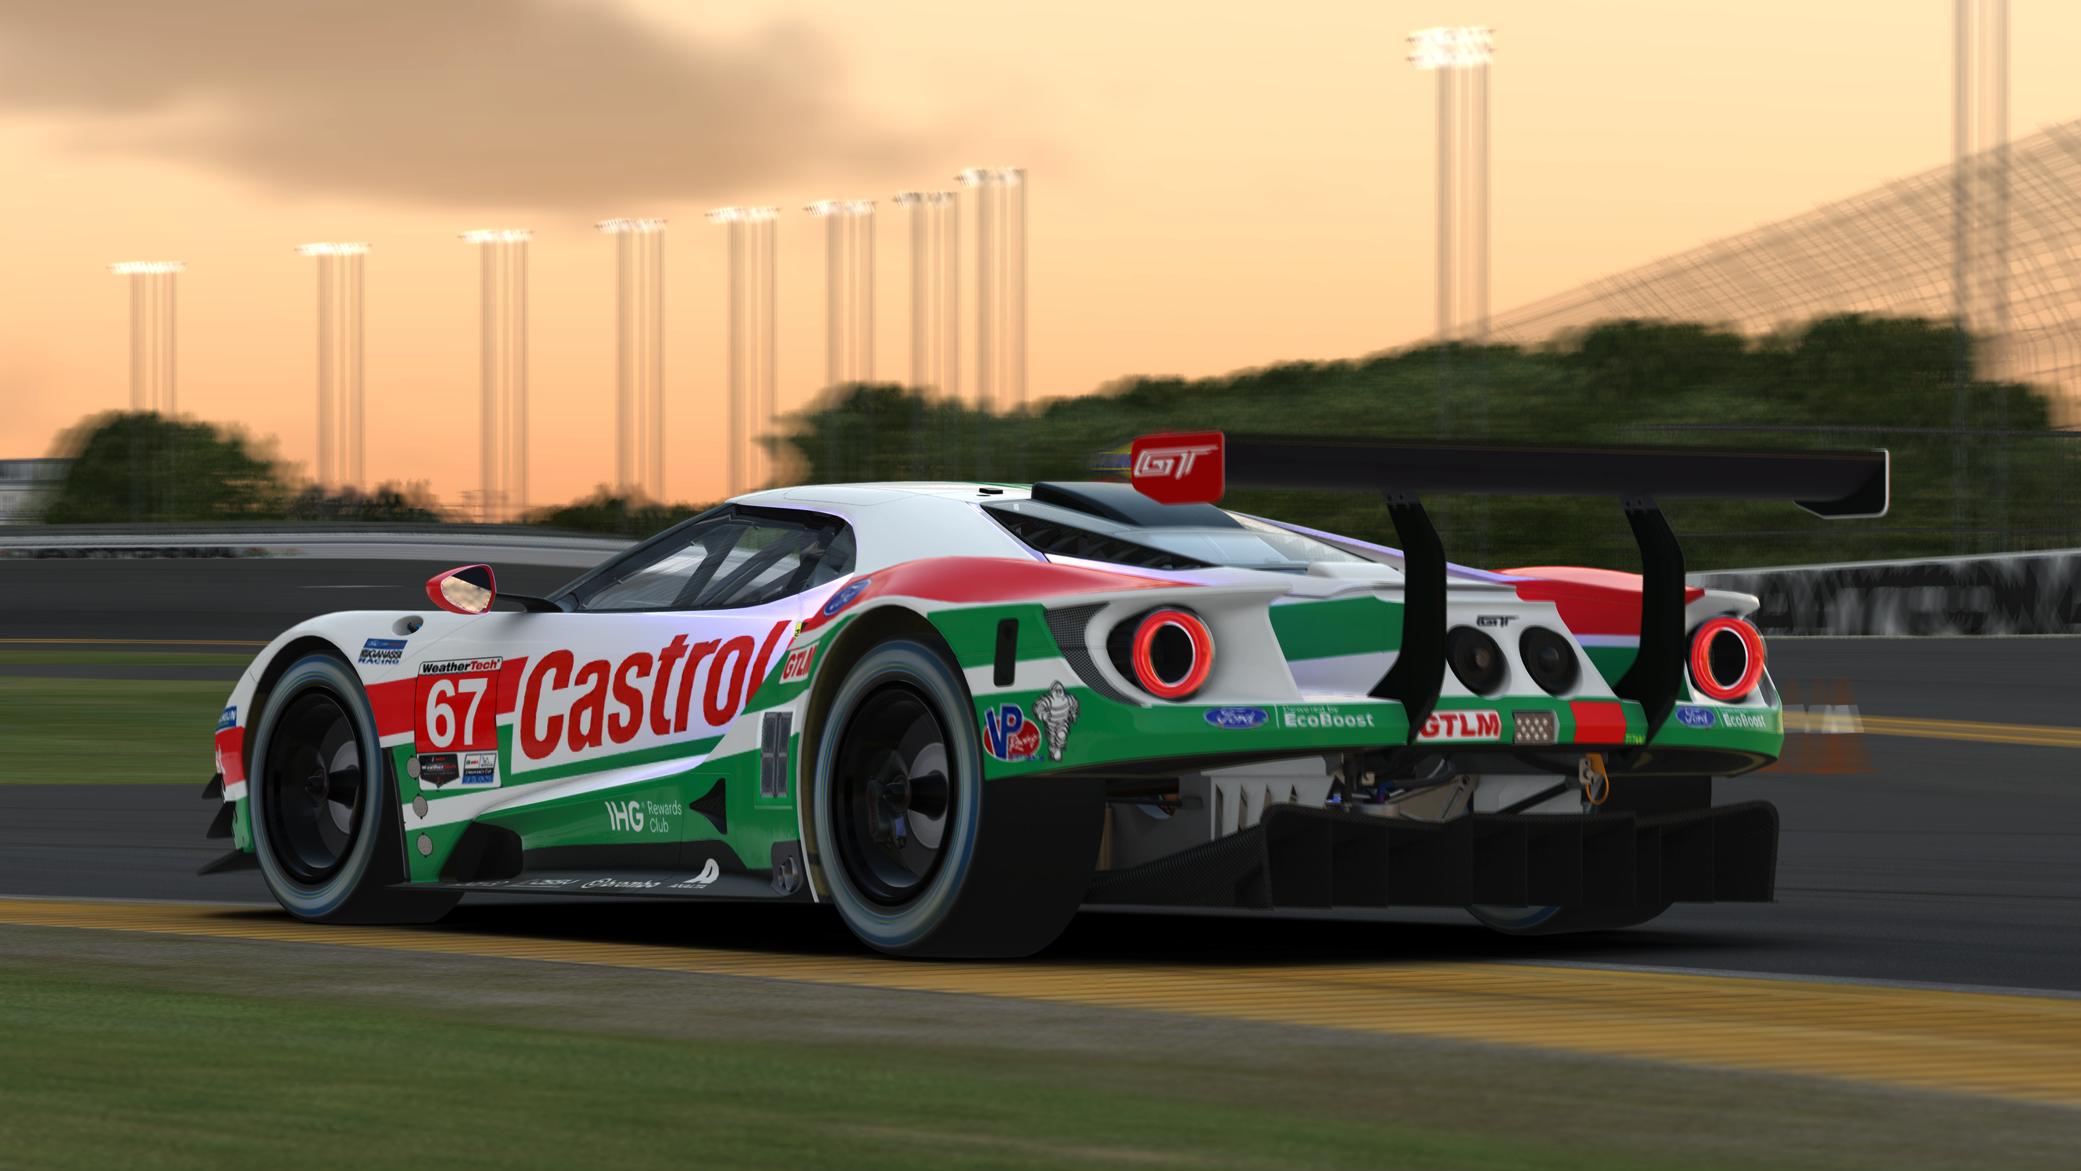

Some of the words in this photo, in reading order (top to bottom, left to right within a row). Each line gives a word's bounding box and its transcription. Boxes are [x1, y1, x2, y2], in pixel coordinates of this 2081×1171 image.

[1134, 444, 1218, 479] GT
[358, 657, 400, 665] RACING
[422, 660, 498, 673] WeatherTech
[520, 619, 792, 760] Castrol
[428, 677, 488, 748] 67
[1284, 712, 1375, 728] EcoBoost
[1722, 711, 1767, 729] EcoBoost
[984, 703, 1025, 760] VP
[1419, 711, 1500, 738] GTLM
[605, 800, 643, 832] IHG
[647, 800, 682, 815] Rewards
[649, 817, 669, 832] Club
